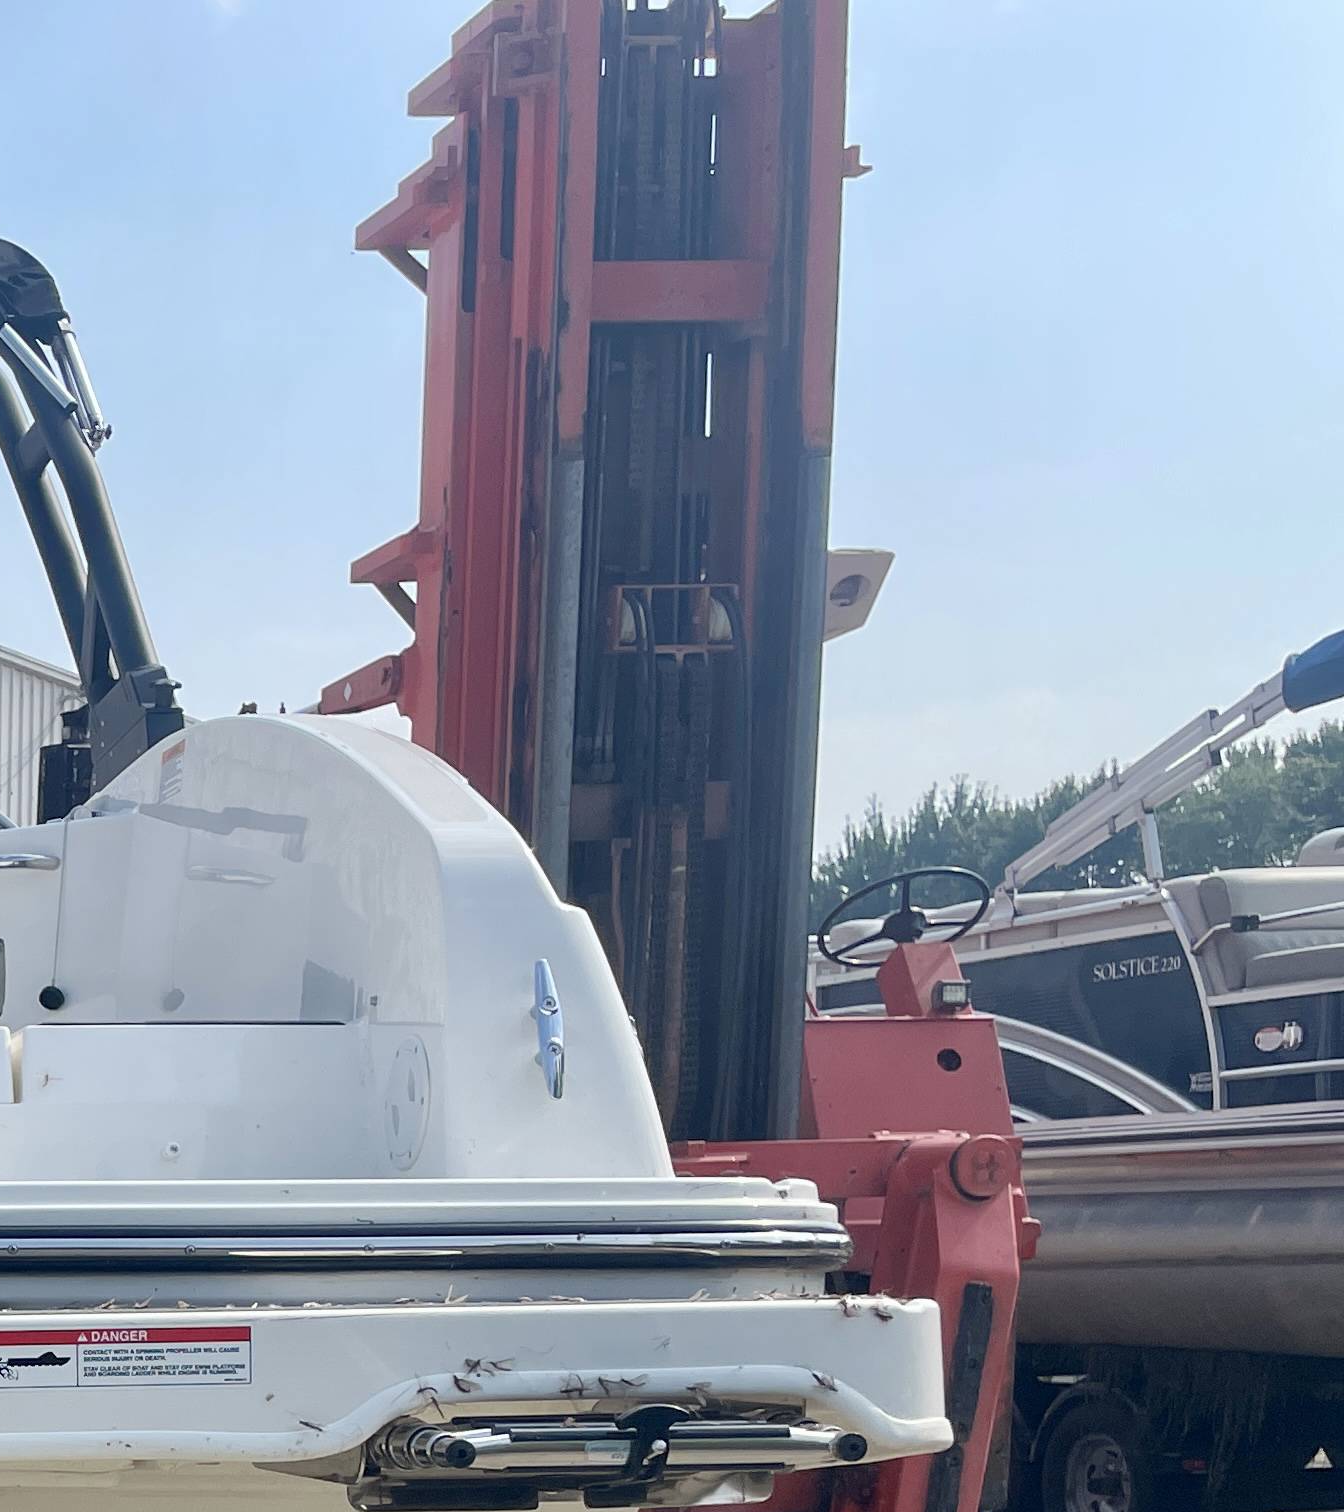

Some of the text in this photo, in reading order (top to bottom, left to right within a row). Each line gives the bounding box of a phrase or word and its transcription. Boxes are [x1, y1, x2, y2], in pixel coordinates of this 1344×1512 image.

[1093, 955, 1181, 982] SOLSTICE 220
[91, 1330, 148, 1342] DANGER
